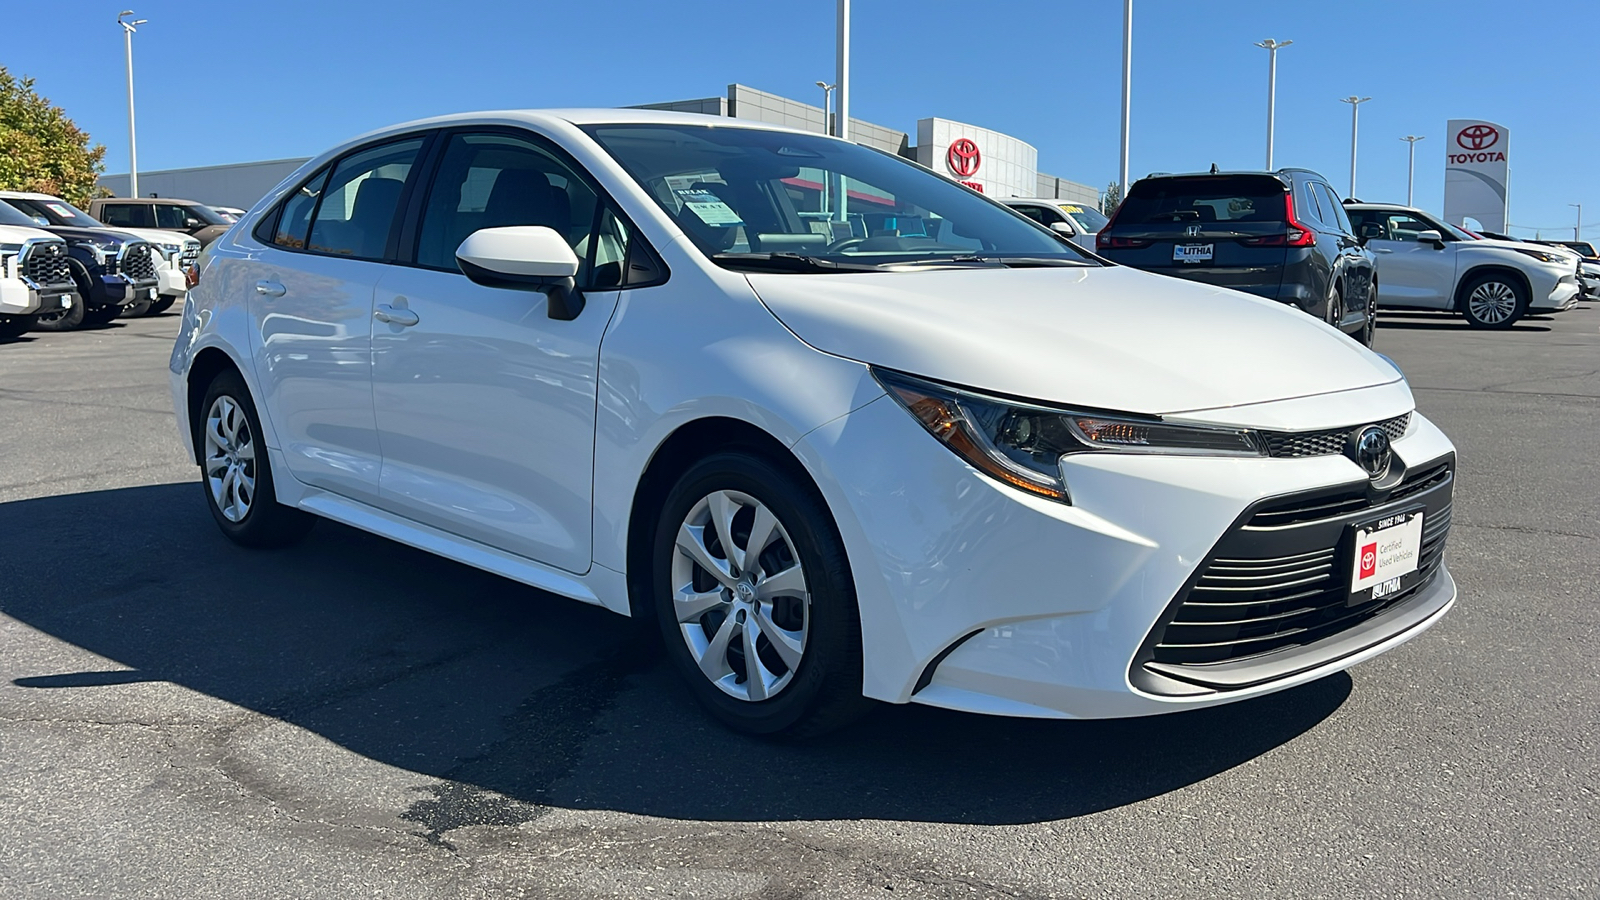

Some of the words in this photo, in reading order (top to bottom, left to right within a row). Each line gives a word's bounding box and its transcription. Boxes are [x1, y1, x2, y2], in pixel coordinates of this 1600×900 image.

[1448, 152, 1505, 164] TOYOTA
[1183, 246, 1212, 256] LITHIA
[1377, 516, 1395, 530] SINCE
[1379, 538, 1403, 555] Certified
[1379, 554, 1394, 568] Used
[1392, 549, 1414, 564] Vehicles
[1379, 576, 1401, 597] LITHIA
